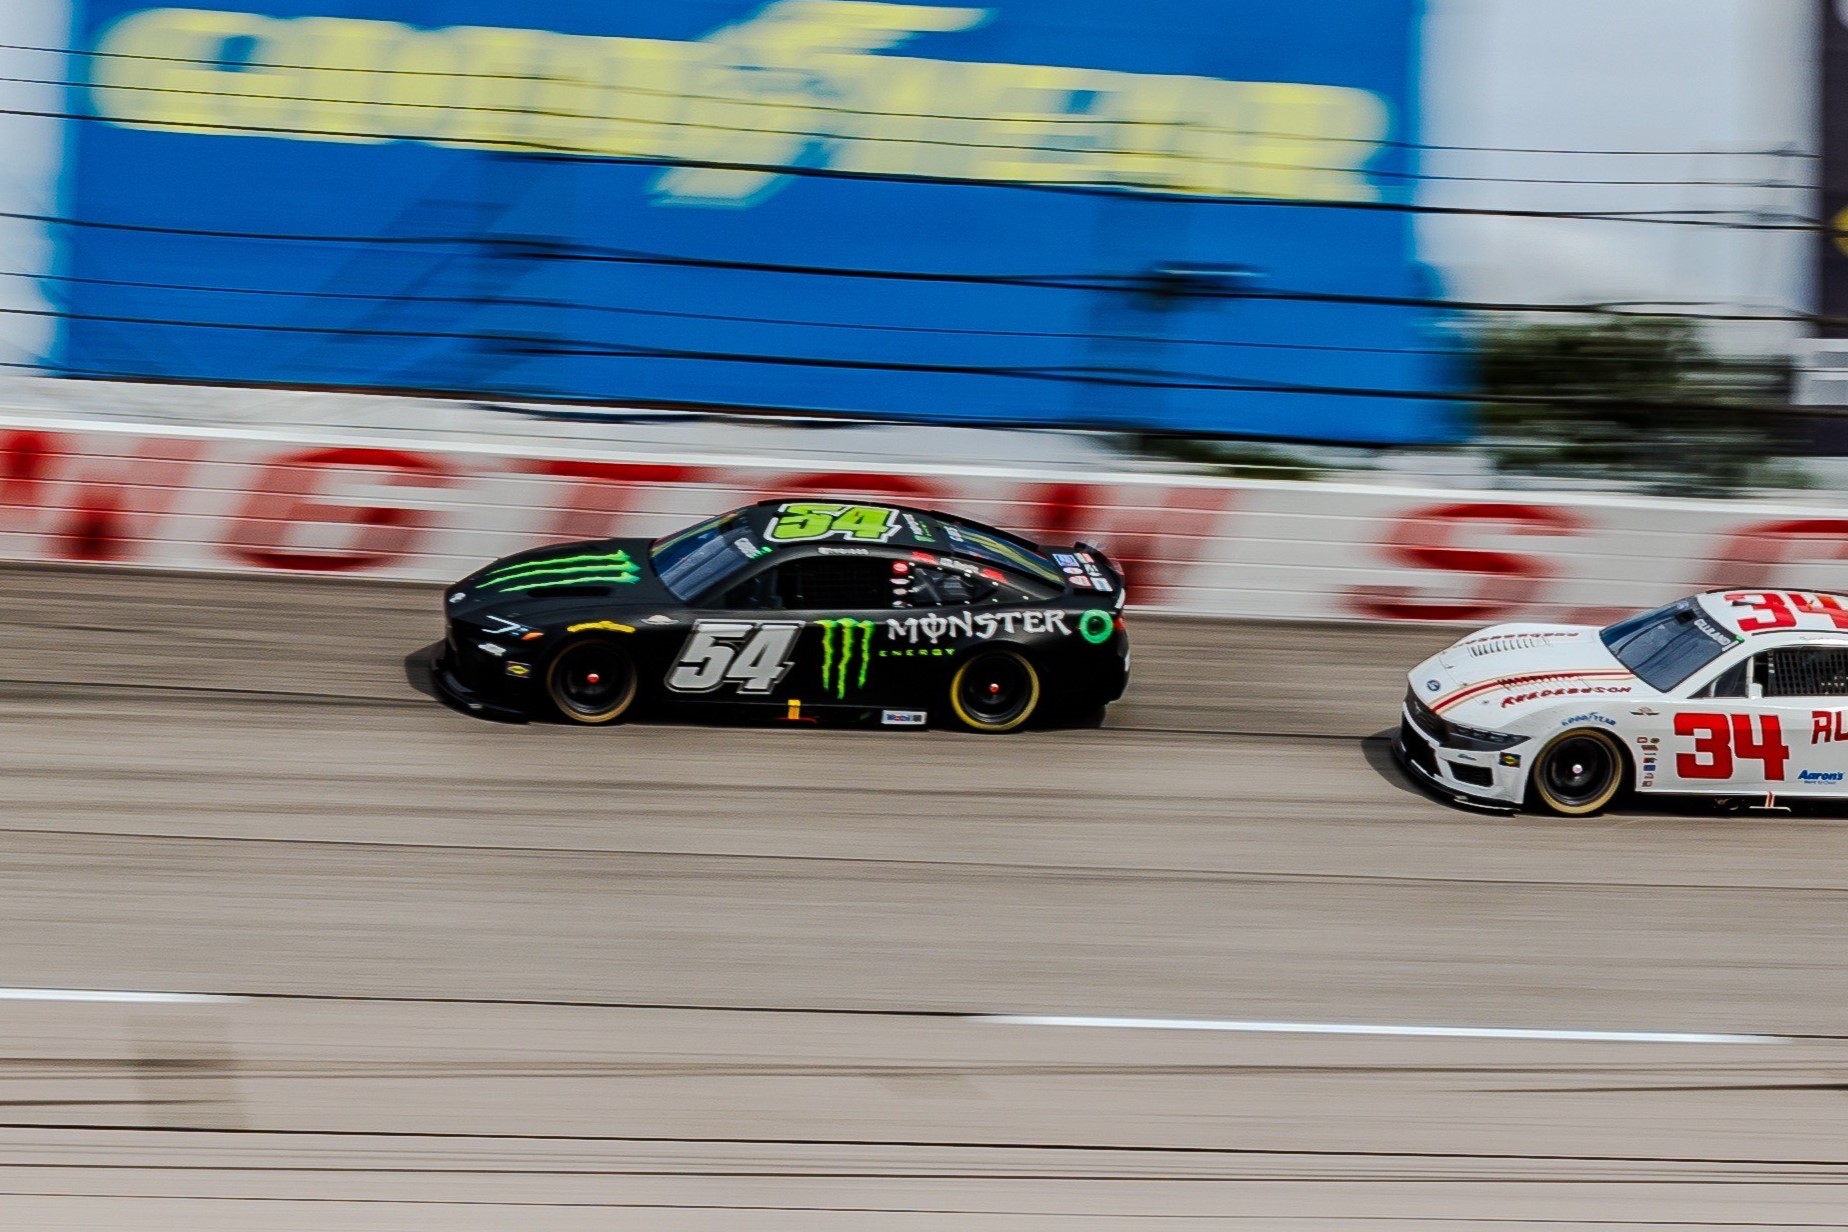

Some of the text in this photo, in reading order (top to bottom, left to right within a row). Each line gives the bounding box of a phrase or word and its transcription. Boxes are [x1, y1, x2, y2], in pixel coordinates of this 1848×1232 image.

[763, 503, 902, 543] 54
[885, 610, 1072, 644] MONSTER
[1723, 592, 1848, 633] 34
[664, 618, 807, 695] 54
[1674, 712, 1790, 781] 34
